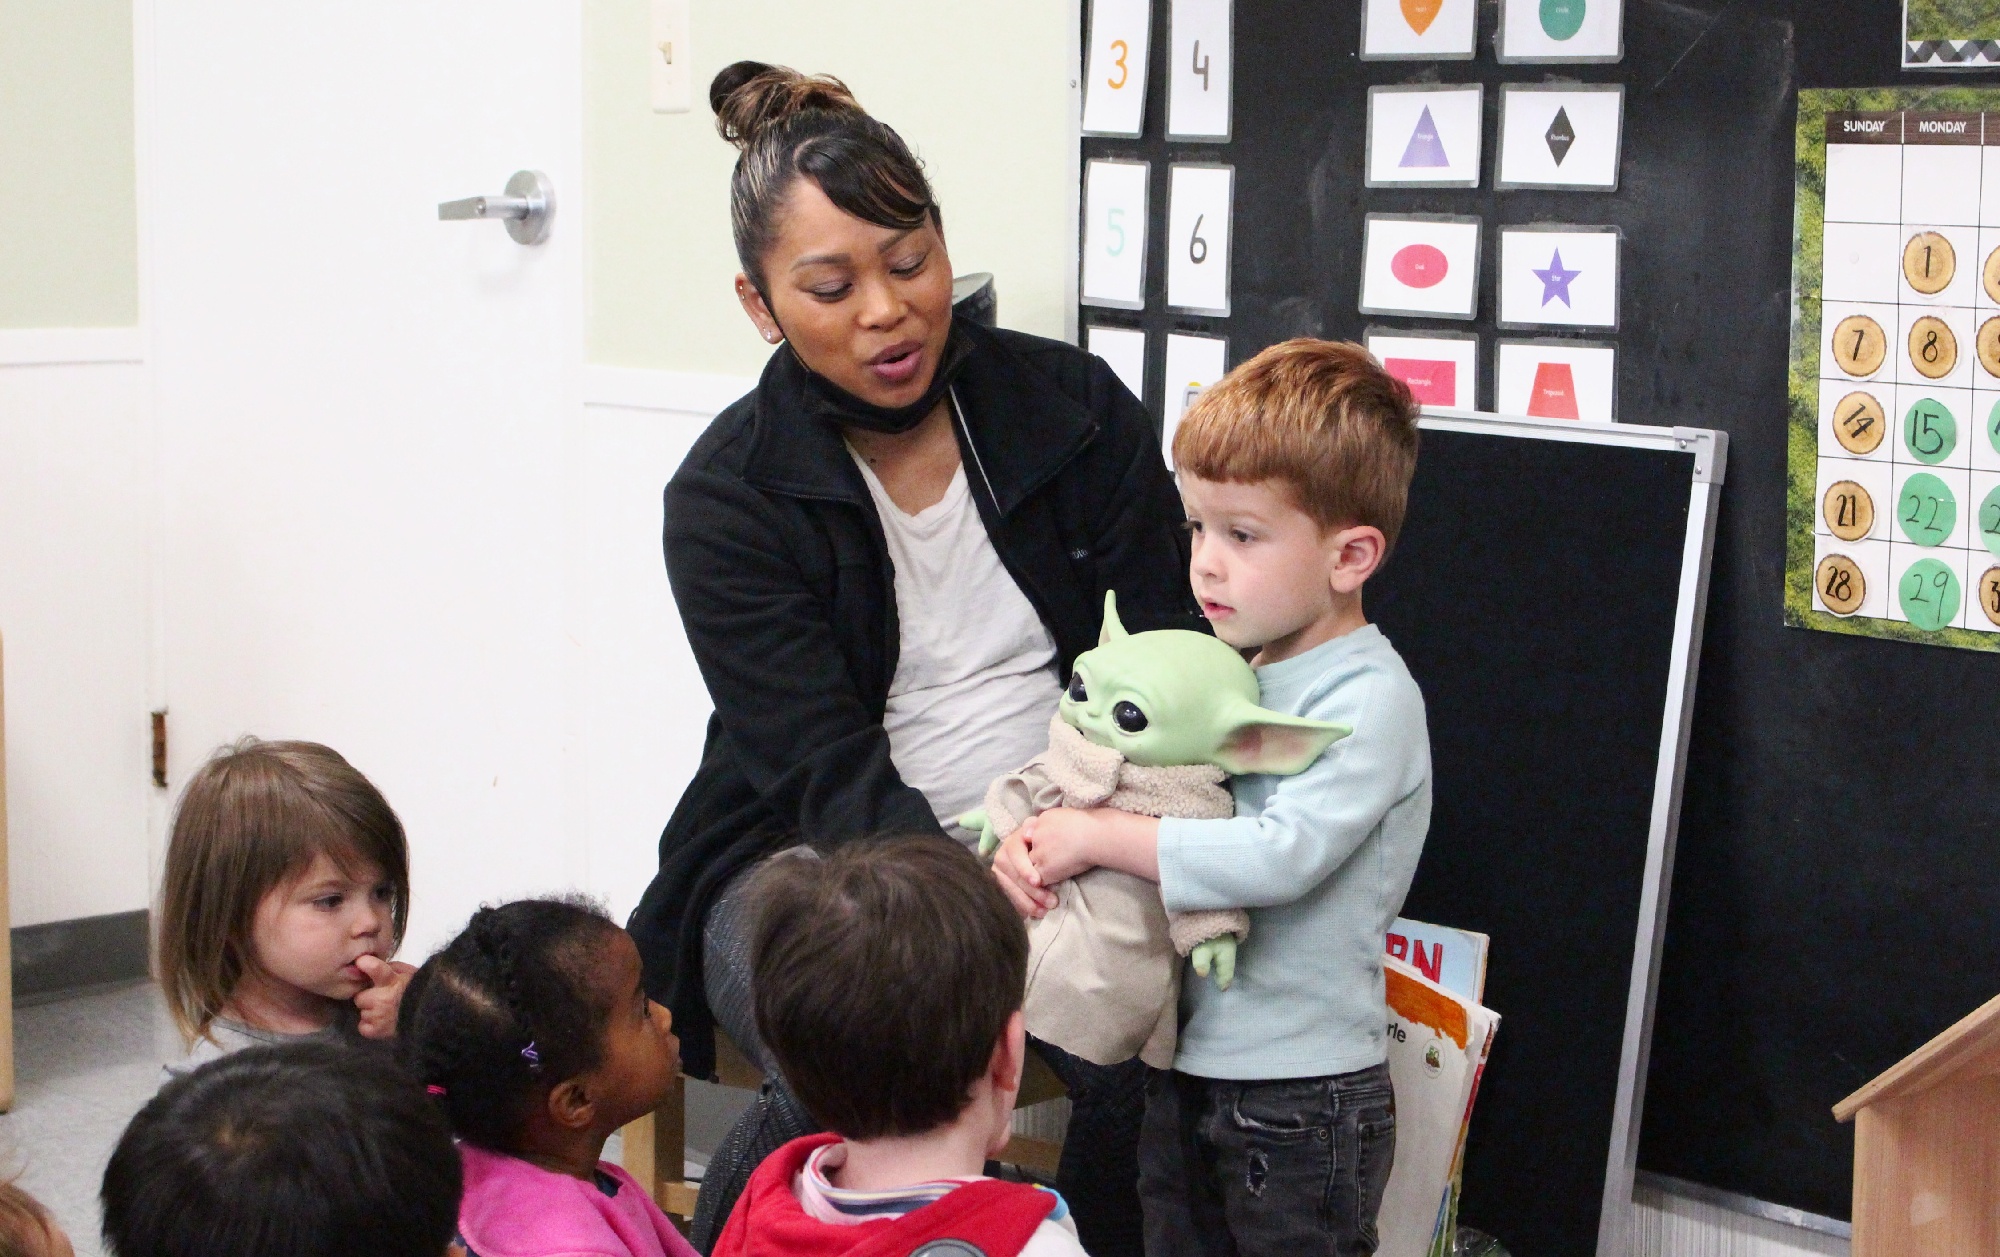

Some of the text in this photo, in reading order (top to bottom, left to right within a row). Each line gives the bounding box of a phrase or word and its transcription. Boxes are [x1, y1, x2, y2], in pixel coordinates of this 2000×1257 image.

[1107, 40, 1129, 90] 3
[1192, 39, 1210, 92] 4
[1843, 120, 1967, 134] SUNDAY MONDAY
[1106, 208, 1127, 258] 5
[1189, 213, 1208, 265] 6
[1923, 245, 1932, 278] 1
[1851, 329, 1865, 361] 7
[1921, 330, 1938, 363] 8
[1843, 403, 1875, 439] 14
[1911, 409, 1944, 455] 15
[1836, 493, 1857, 527] 21
[1905, 495, 1943, 532] 22
[1825, 565, 1852, 602] 28
[1910, 571, 1949, 624] 29
